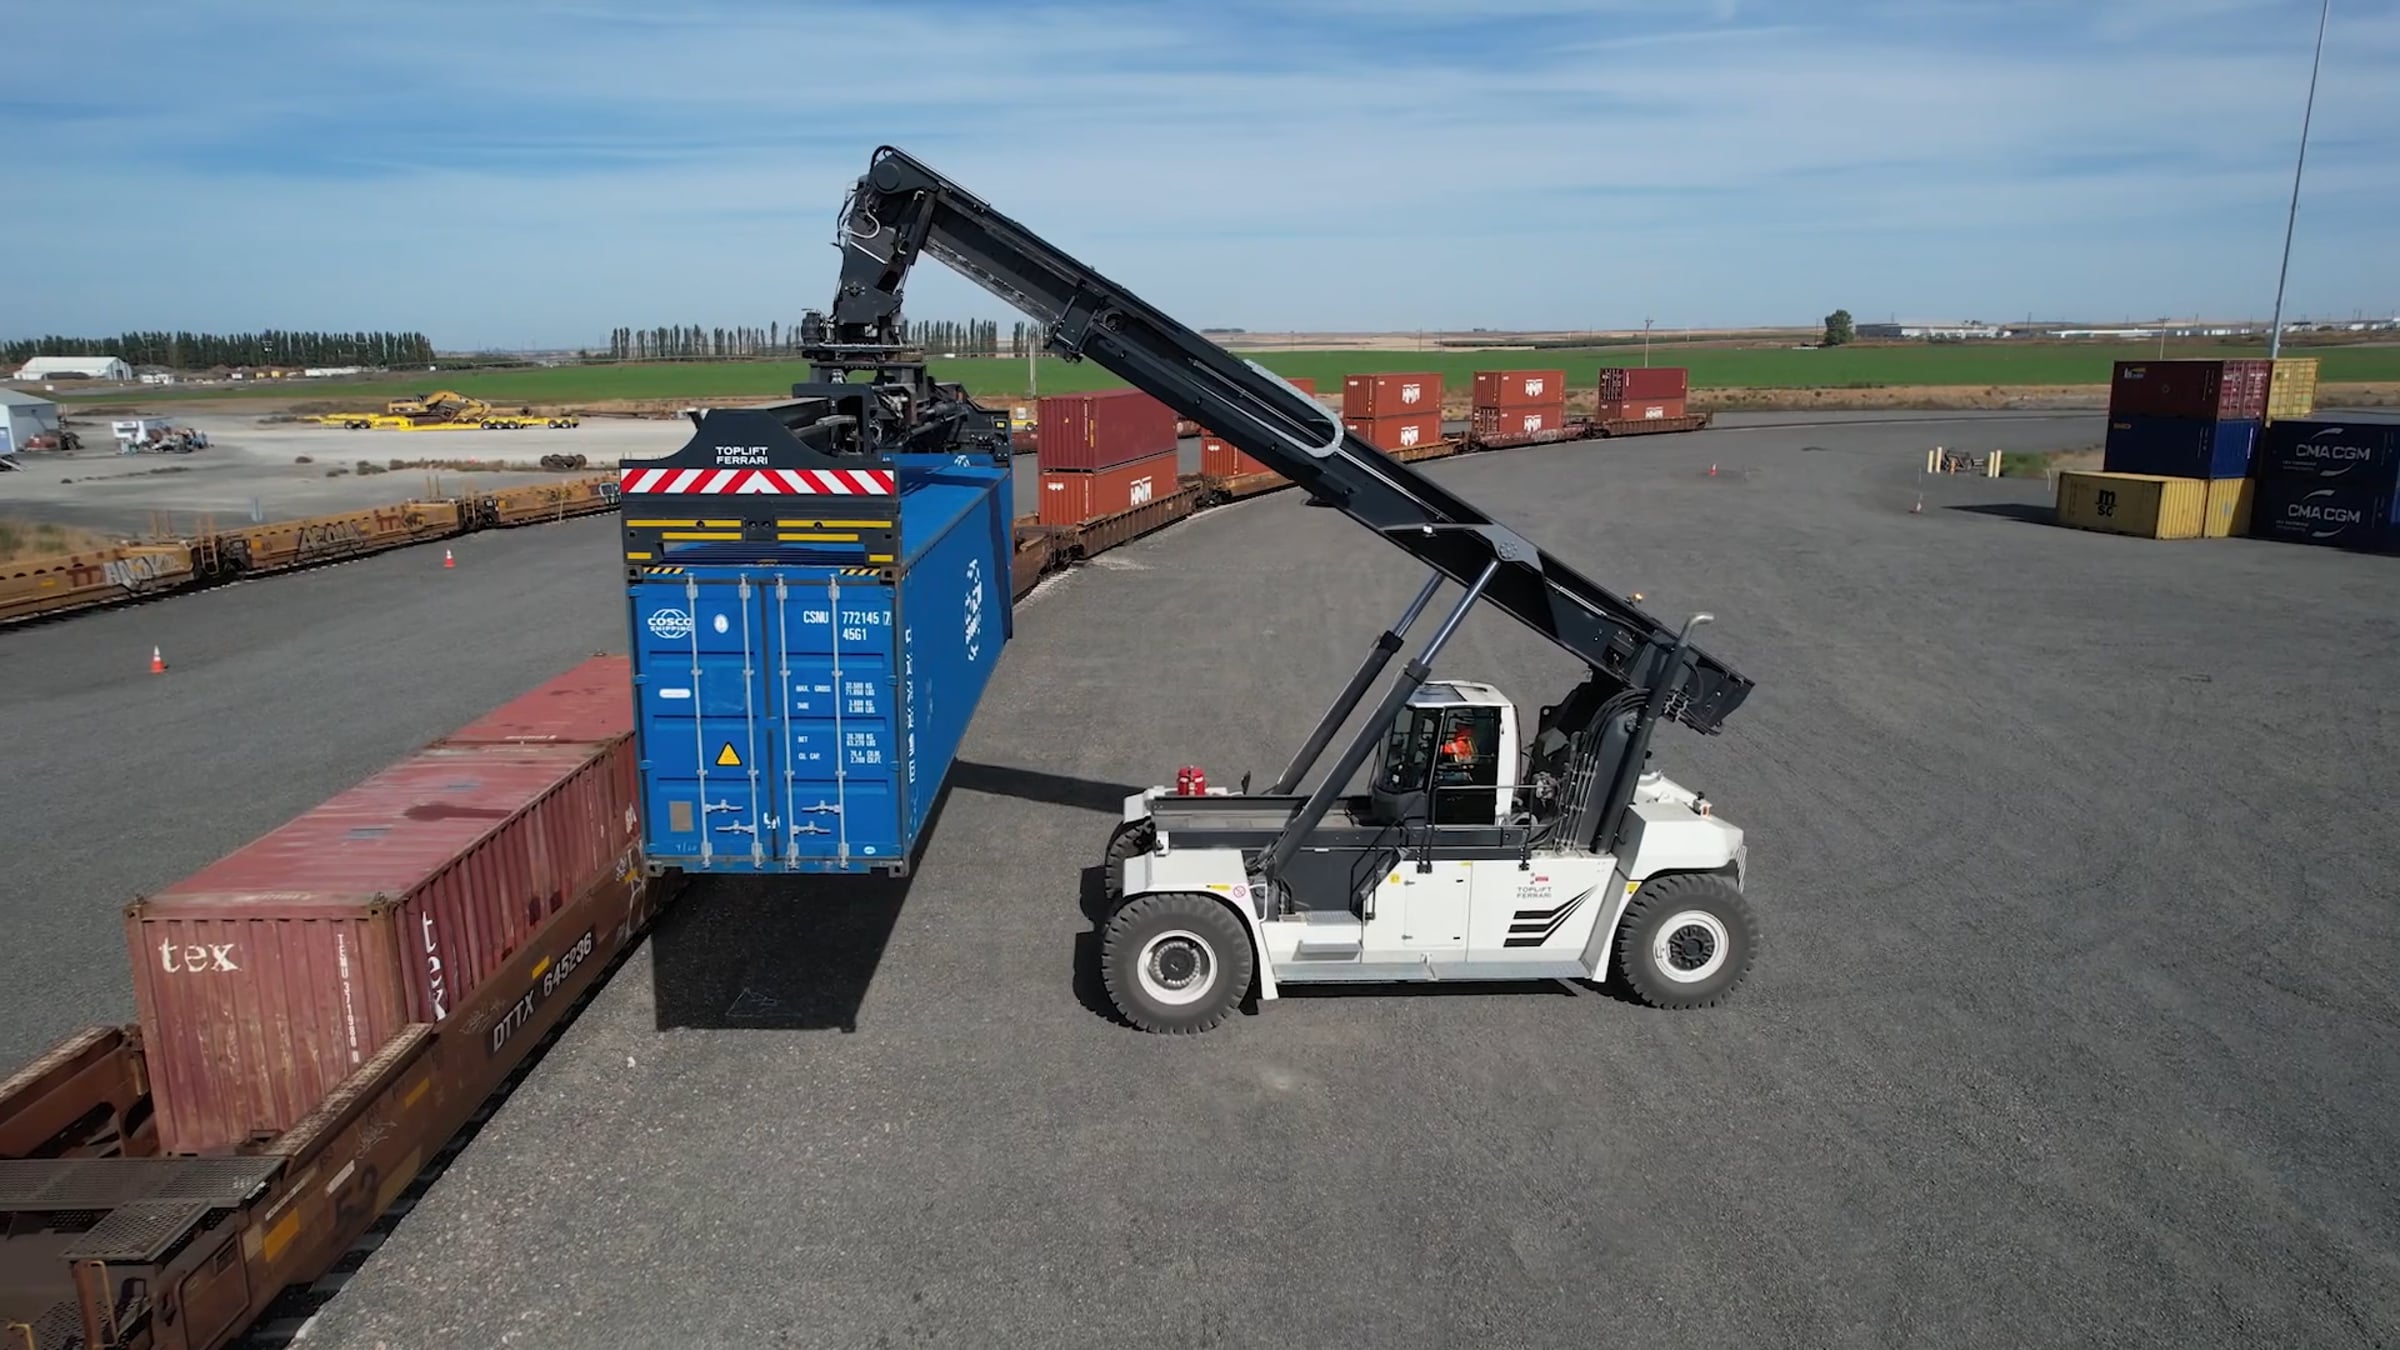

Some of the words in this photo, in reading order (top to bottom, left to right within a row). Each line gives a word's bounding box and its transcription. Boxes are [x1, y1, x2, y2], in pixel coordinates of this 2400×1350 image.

[715, 446, 769, 456] TOPLIFT
[2296, 444, 2330, 458] CMA
[2332, 446, 2371, 461] CGM
[715, 456, 769, 465] FERRARI
[2288, 504, 2321, 519] CMA
[2323, 507, 2361, 523] CGM
[648, 617, 692, 626] COSCO
[841, 611, 880, 625] 772145
[884, 611, 891, 625] 7
[842, 628, 867, 641] 45G1
[158, 937, 239, 973] tex
[493, 990, 536, 1052] DTTX
[543, 931, 593, 998] 645236
